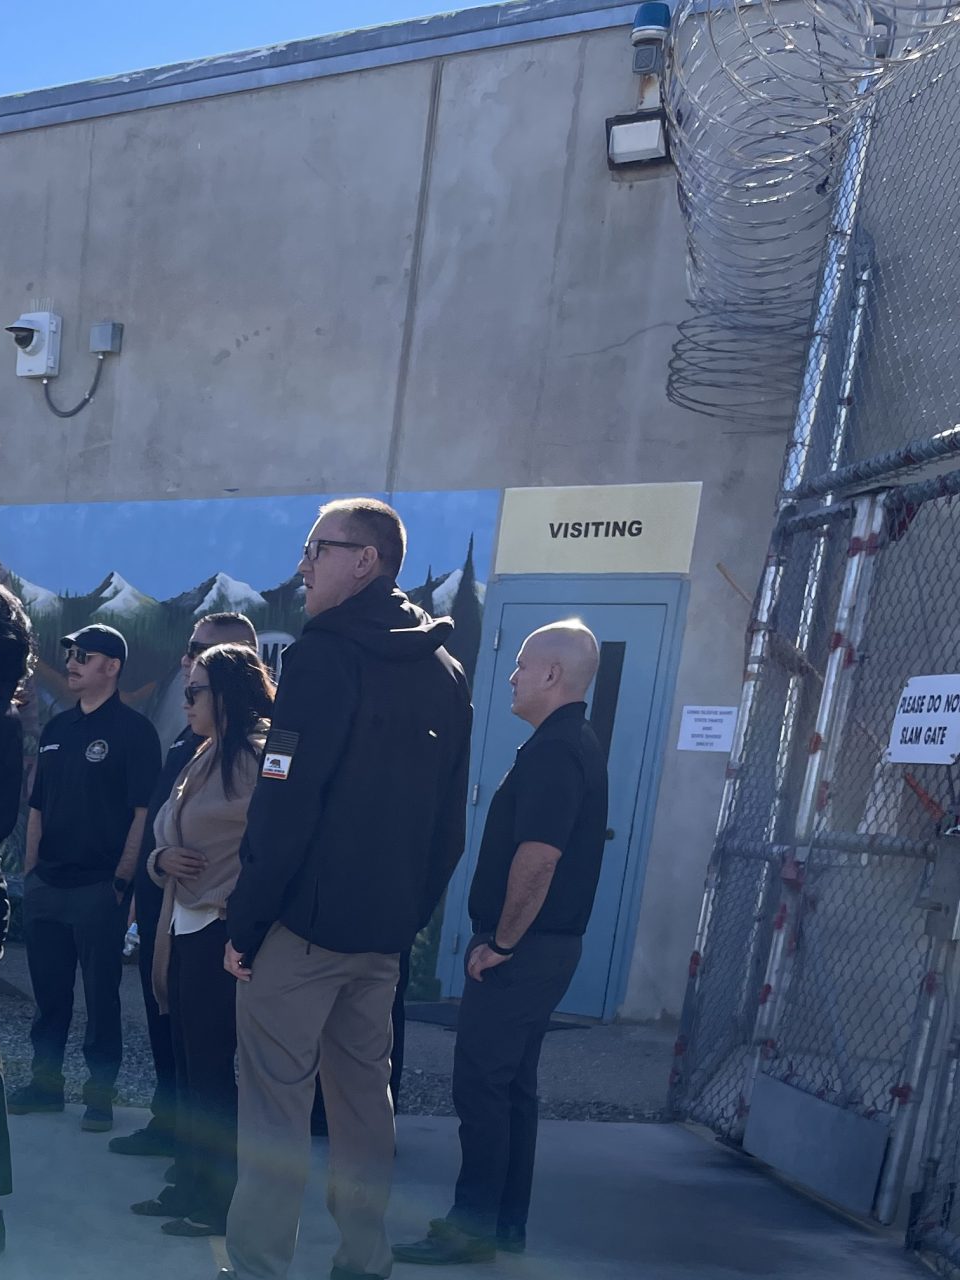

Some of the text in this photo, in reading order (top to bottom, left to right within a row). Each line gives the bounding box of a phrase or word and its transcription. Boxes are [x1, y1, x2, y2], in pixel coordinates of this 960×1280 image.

[549, 521, 642, 538] VISITING
[898, 693, 960, 714] PLEASE DO NO
[900, 726, 947, 745] SLAM GATE
